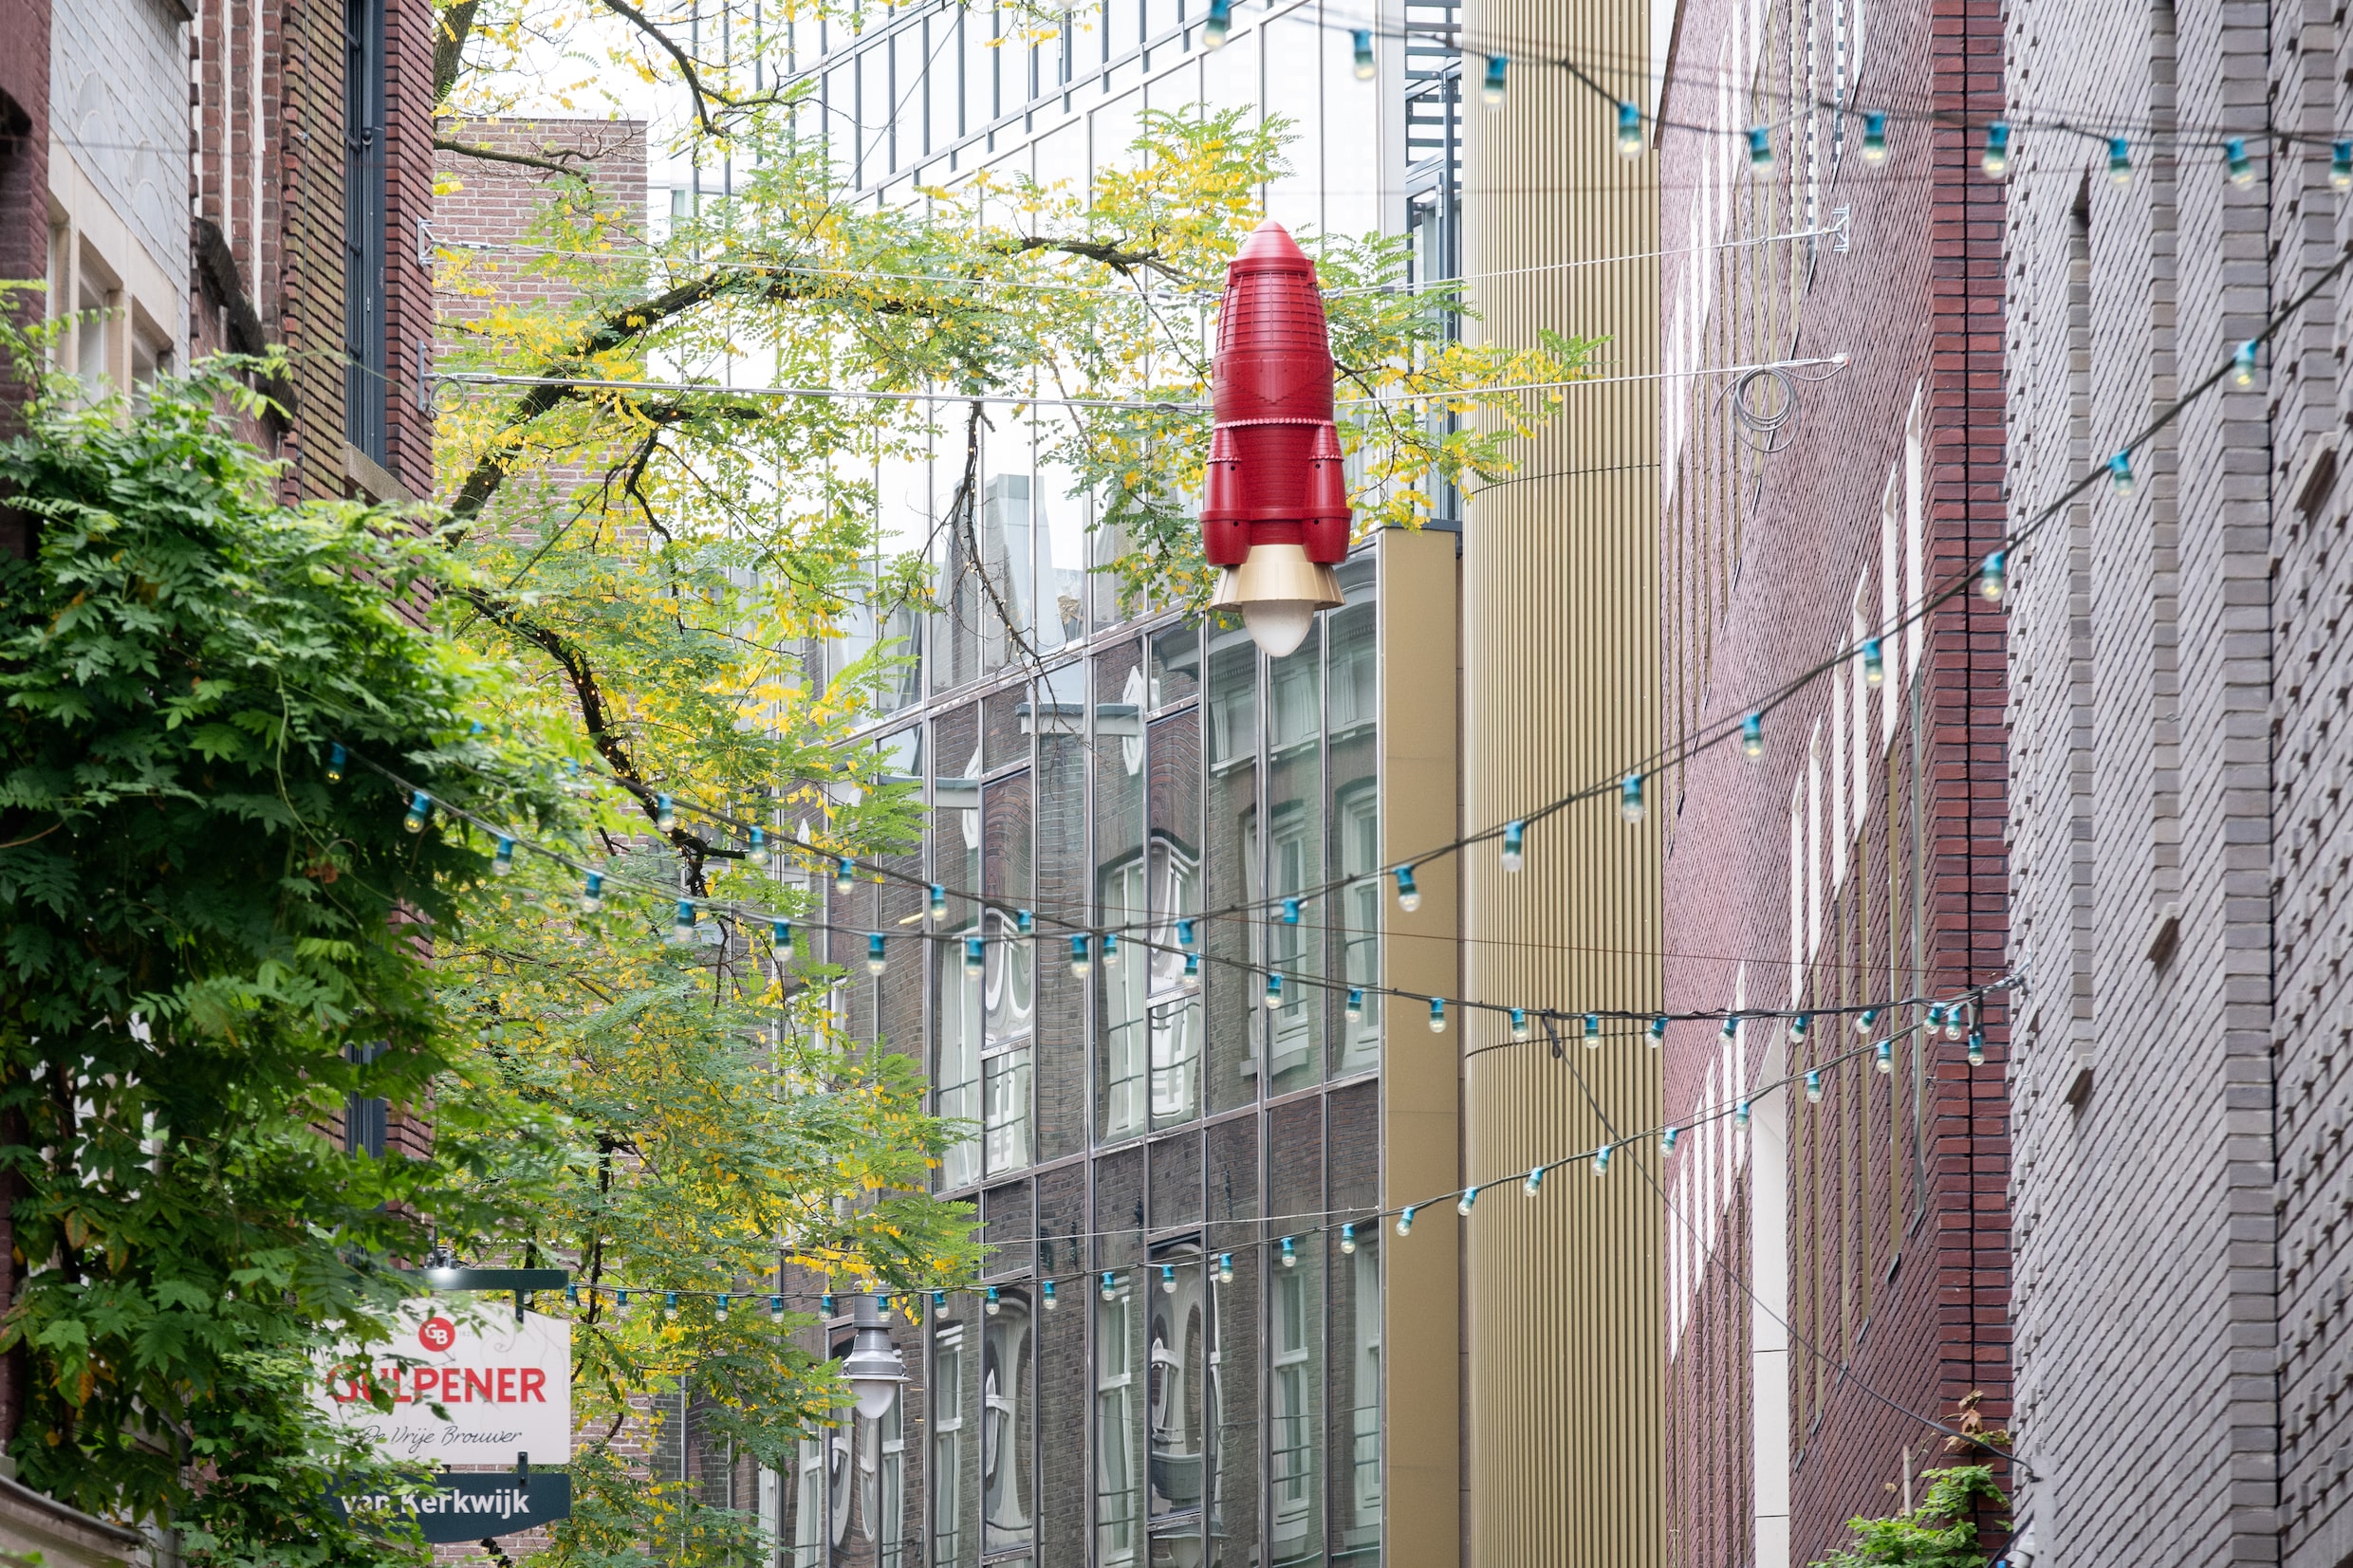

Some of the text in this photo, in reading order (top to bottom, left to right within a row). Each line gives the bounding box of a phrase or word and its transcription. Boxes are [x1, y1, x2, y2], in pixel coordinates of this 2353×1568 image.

[325, 1363, 547, 1403] GULPENER
[390, 1426, 435, 1453] Vrije
[441, 1425, 523, 1447] Brouwer
[341, 1488, 530, 1520] van Kerkwijk
